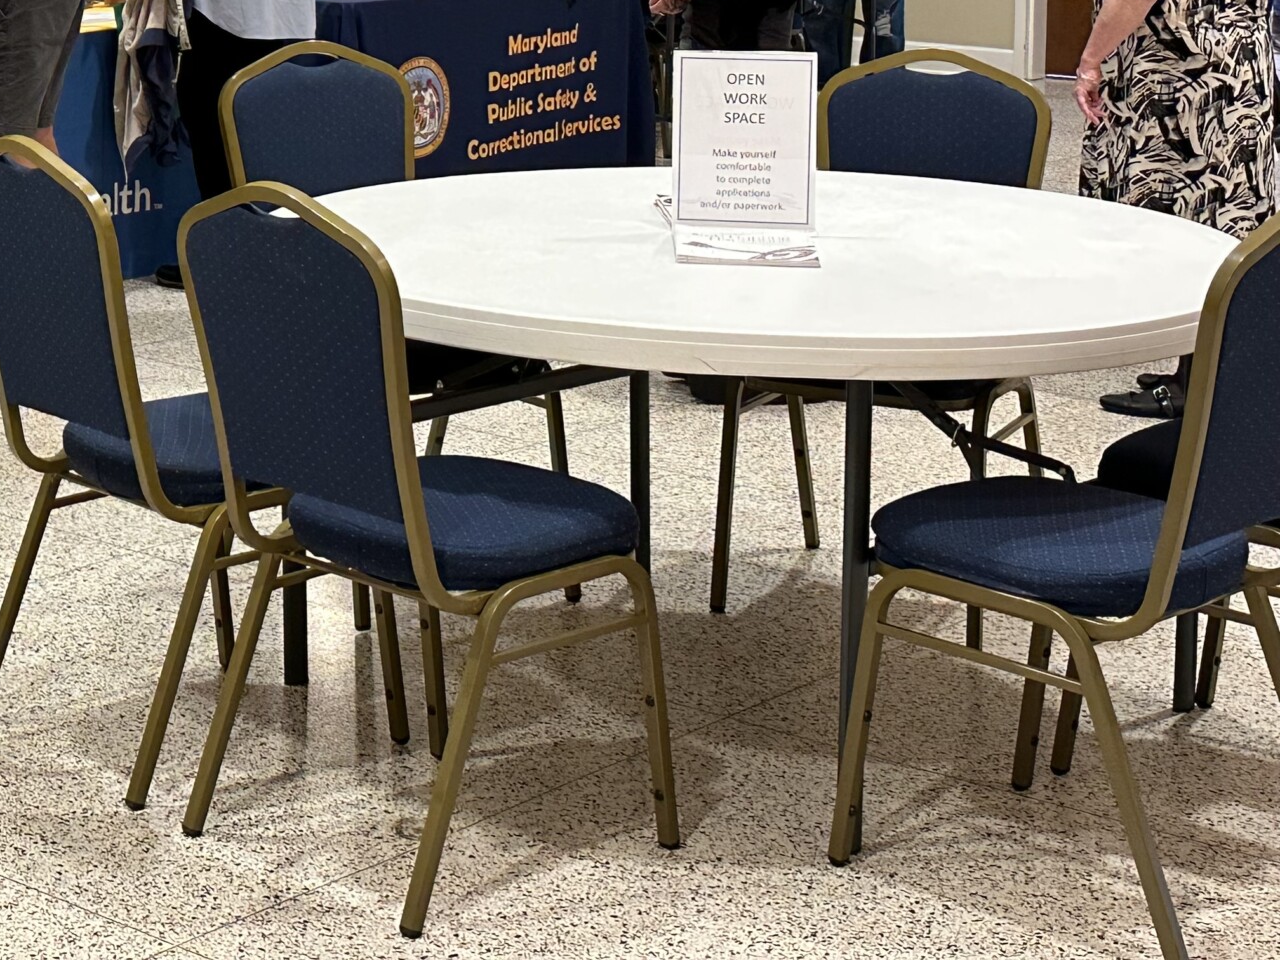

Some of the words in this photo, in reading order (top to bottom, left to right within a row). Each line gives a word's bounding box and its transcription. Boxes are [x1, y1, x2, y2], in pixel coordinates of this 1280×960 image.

[508, 22, 579, 56] Maryland
[488, 57, 576, 91] Department
[579, 50, 597, 71] of
[726, 73, 765, 86] OPEN
[487, 97, 533, 124] Public
[537, 88, 579, 114] Safety
[584, 82, 597, 102] &
[724, 93, 767, 105] WORK
[724, 112, 766, 125] SPACE
[467, 122, 559, 159] Correctional
[561, 114, 621, 140] Services
[712, 148, 737, 158] Make
[740, 150, 777, 159] yourself
[716, 162, 772, 172] comfortable
[716, 175, 726, 183] to
[728, 175, 771, 186] complete
[101, 179, 151, 216] alth
[716, 188, 771, 198] applications
[700, 200, 731, 210] and/or
